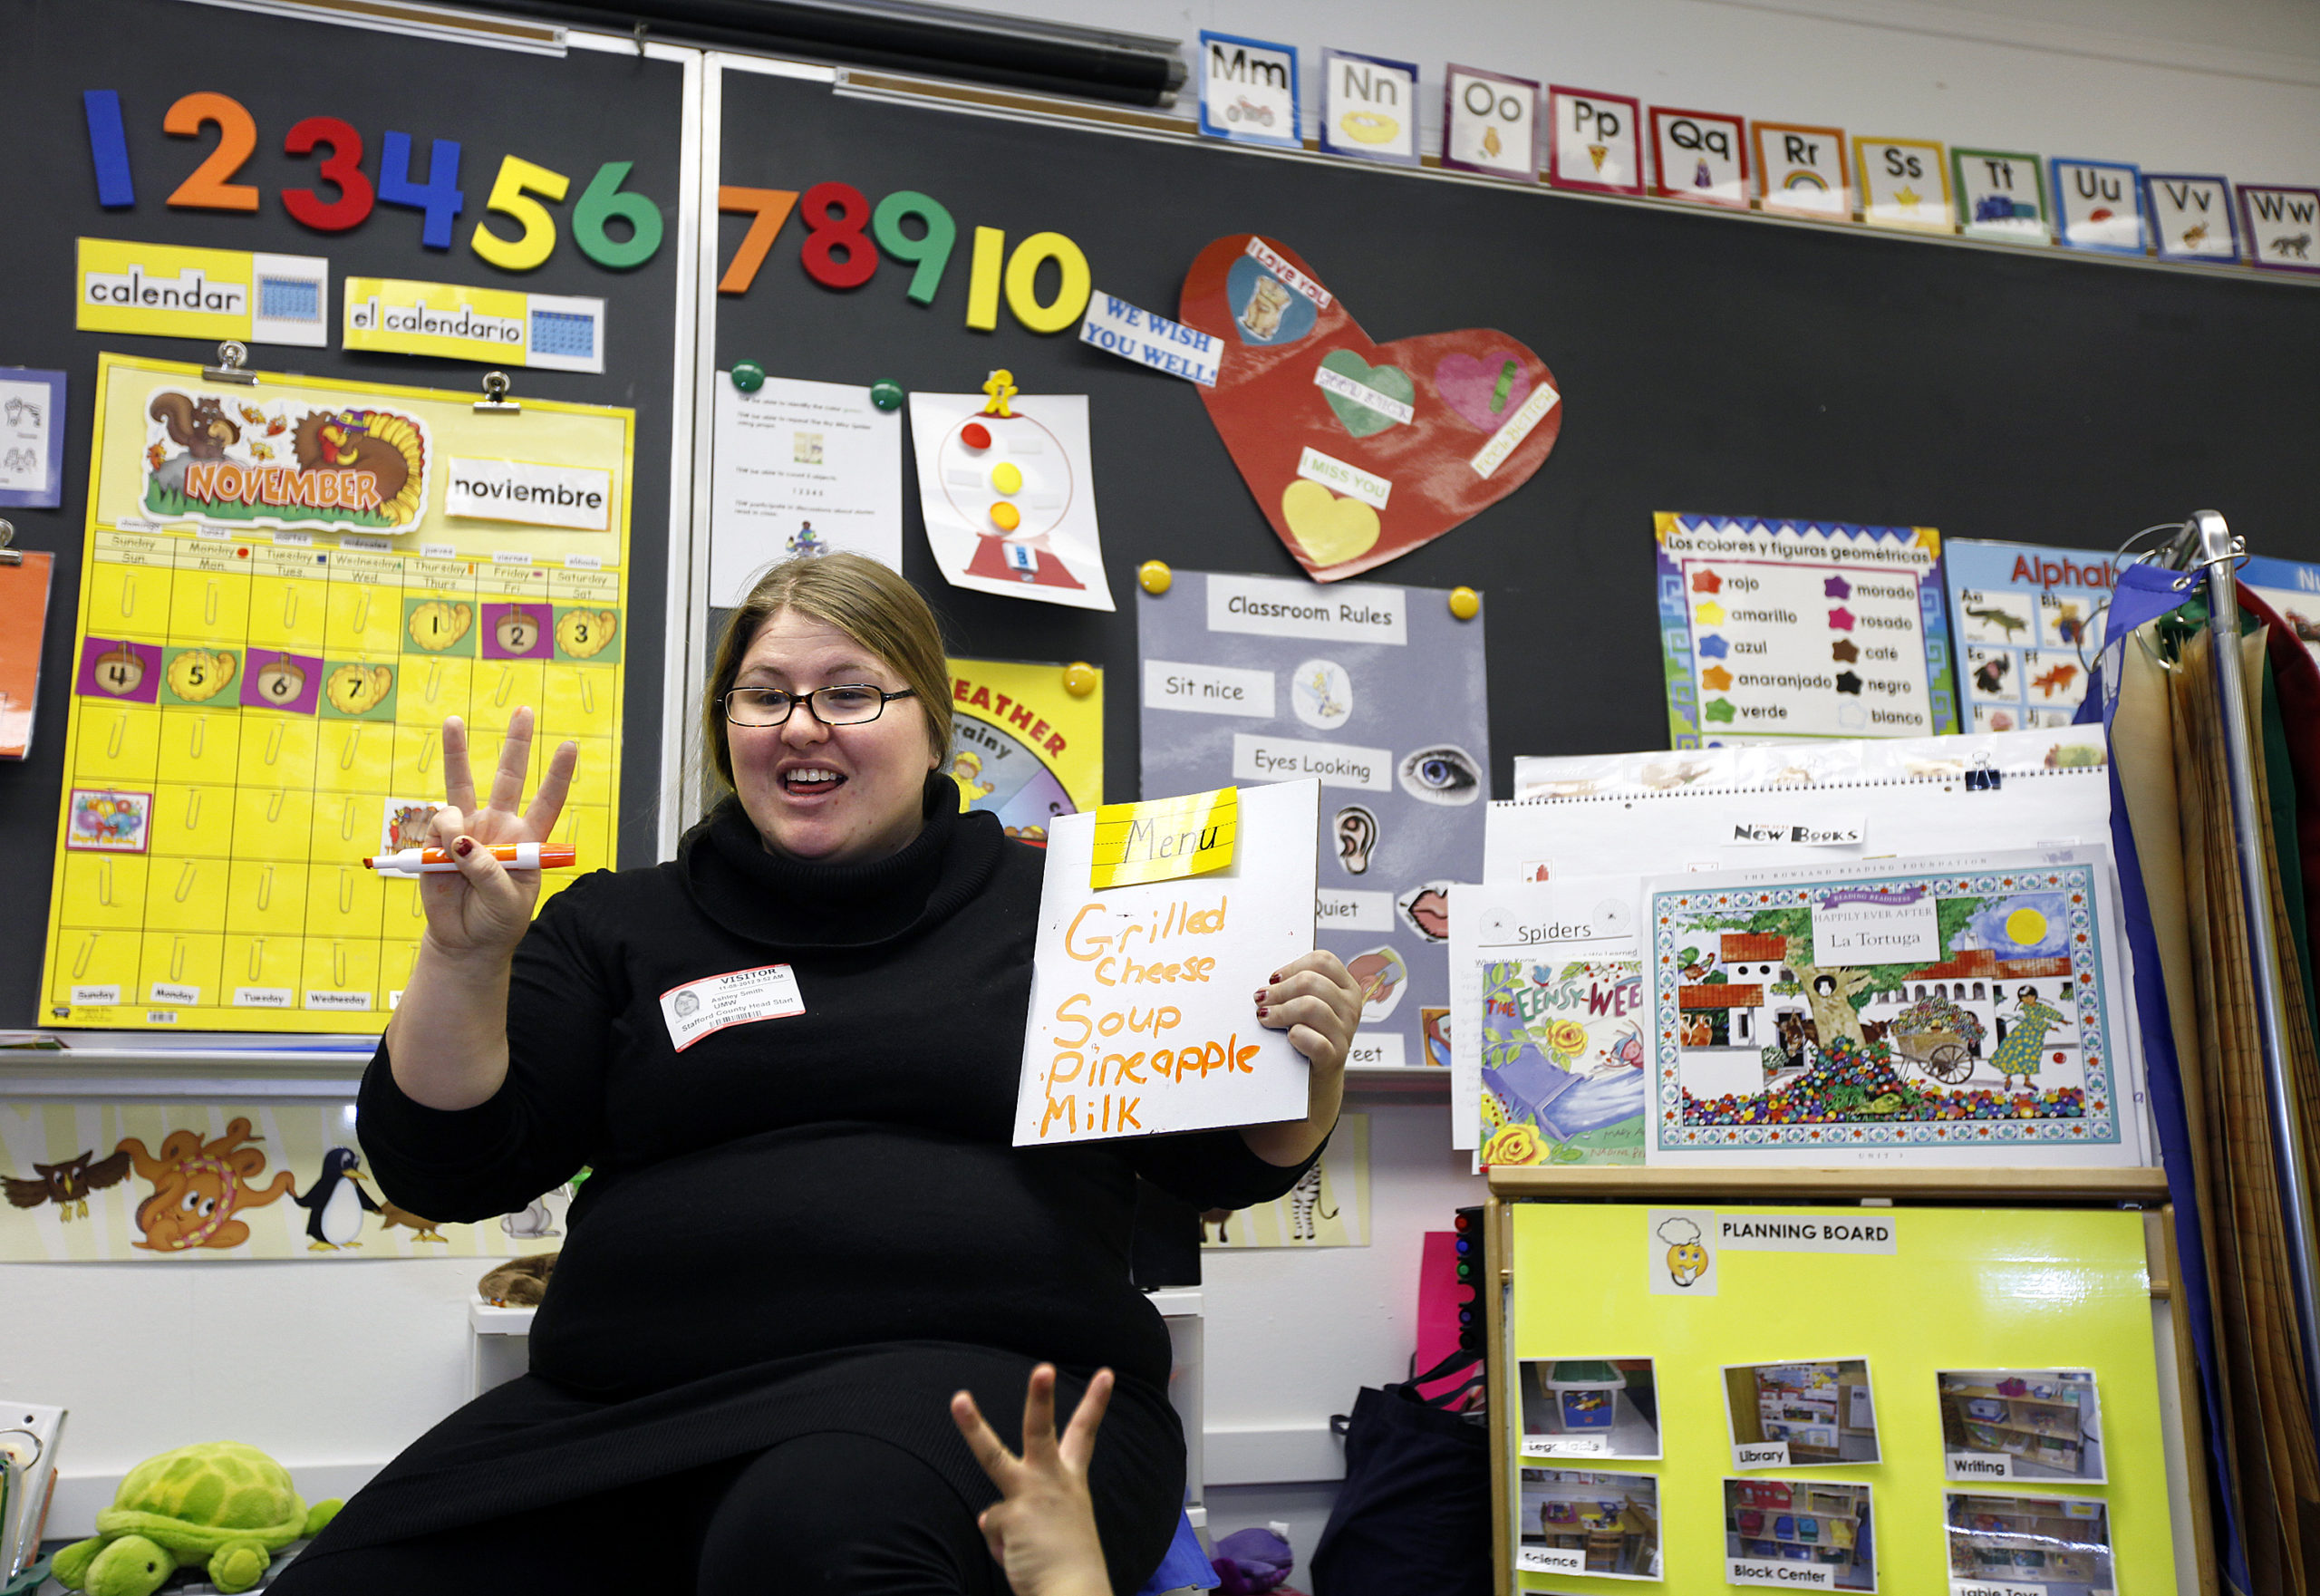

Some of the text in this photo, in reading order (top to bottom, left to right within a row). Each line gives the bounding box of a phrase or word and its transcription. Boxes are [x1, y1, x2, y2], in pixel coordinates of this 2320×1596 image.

[1212, 44, 1287, 89] Mm
[1344, 63, 1397, 105] Nn
[1464, 81, 1522, 121] Oo
[1573, 101, 1620, 141] Pp
[1669, 120, 1731, 161] Qq
[1784, 135, 1819, 166] Rr
[1884, 147, 1922, 179] Ss
[1985, 160, 2014, 189] Tt
[2075, 168, 2121, 201] Uu
[2165, 180, 2211, 212] Vv
[83, 90, 1091, 332] 1 2 3 4 5 6 7 8 9 10
[2251, 192, 2315, 224] Ww
[90, 271, 241, 311] calendar
[353, 296, 520, 343] el calendario
[1107, 295, 1212, 353] WE WISH
[1088, 322, 1136, 355] YOU
[186, 460, 382, 511] NOVEMBER
[1311, 458, 1349, 483] MISS
[1354, 473, 1387, 498] YOU
[454, 478, 603, 510] noviembre
[111, 535, 156, 551] Sunday
[188, 542, 235, 558] Monday
[1668, 536, 1693, 551] Los
[1696, 539, 1755, 554] colores
[1758, 544, 1768, 558] y
[1771, 541, 1828, 562] figuras
[266, 547, 313, 564] Tuesday
[336, 555, 398, 572] Wednesday
[413, 560, 467, 576] Thursday
[493, 566, 529, 582] Friday
[557, 571, 608, 586] Saturday
[1728, 576, 1759, 594] rojo
[1857, 584, 1916, 600] morado
[1227, 595, 1393, 625] Classroom Rules
[1732, 606, 1798, 624] amarillo
[431, 615, 439, 634] 1
[1861, 614, 1913, 630] rosado
[510, 627, 524, 646] 2
[574, 624, 589, 643] 3
[1735, 640, 1767, 654] azul
[1865, 646, 1899, 662] café
[108, 665, 128, 688] 4
[188, 666, 204, 686] 5
[1738, 673, 1832, 692] anaranjado
[271, 677, 287, 696] 6
[347, 679, 362, 699] 7
[1165, 676, 1245, 701] Sit nice
[1868, 679, 1912, 697] negro
[948, 677, 1067, 760] EATHER
[1741, 705, 1788, 720] verde
[1871, 709, 1923, 725] blanco
[1254, 749, 1371, 783] Eyes Looking
[1124, 817, 1218, 864] Menu
[1734, 823, 1859, 843] New Books
[1814, 907, 1933, 923] HAPPILY EVER AFTER
[1065, 895, 1227, 962] Grilled
[1518, 922, 1591, 944] Spiders
[1831, 932, 1920, 948] La Tortuga
[720, 968, 778, 985] VISITOR
[78, 989, 115, 1001] Sunday
[155, 987, 195, 1003] Monday
[711, 987, 764, 1004] Ashley Smith
[713, 999, 737, 1011] UMW
[1487, 981, 1643, 1022] THE EENSY-WEE
[682, 997, 794, 1033] Stafford County Head Start
[1053, 992, 1182, 1049] Soup
[1348, 1044, 1383, 1063] eet
[1039, 1093, 1142, 1138] Milk
[1722, 1223, 1890, 1242] PLANNING BOARD
[1738, 1447, 1784, 1464] Library
[1954, 1459, 2006, 1475] Writing
[1523, 1551, 1579, 1569] Science
[1733, 1564, 1826, 1583] Block Center
